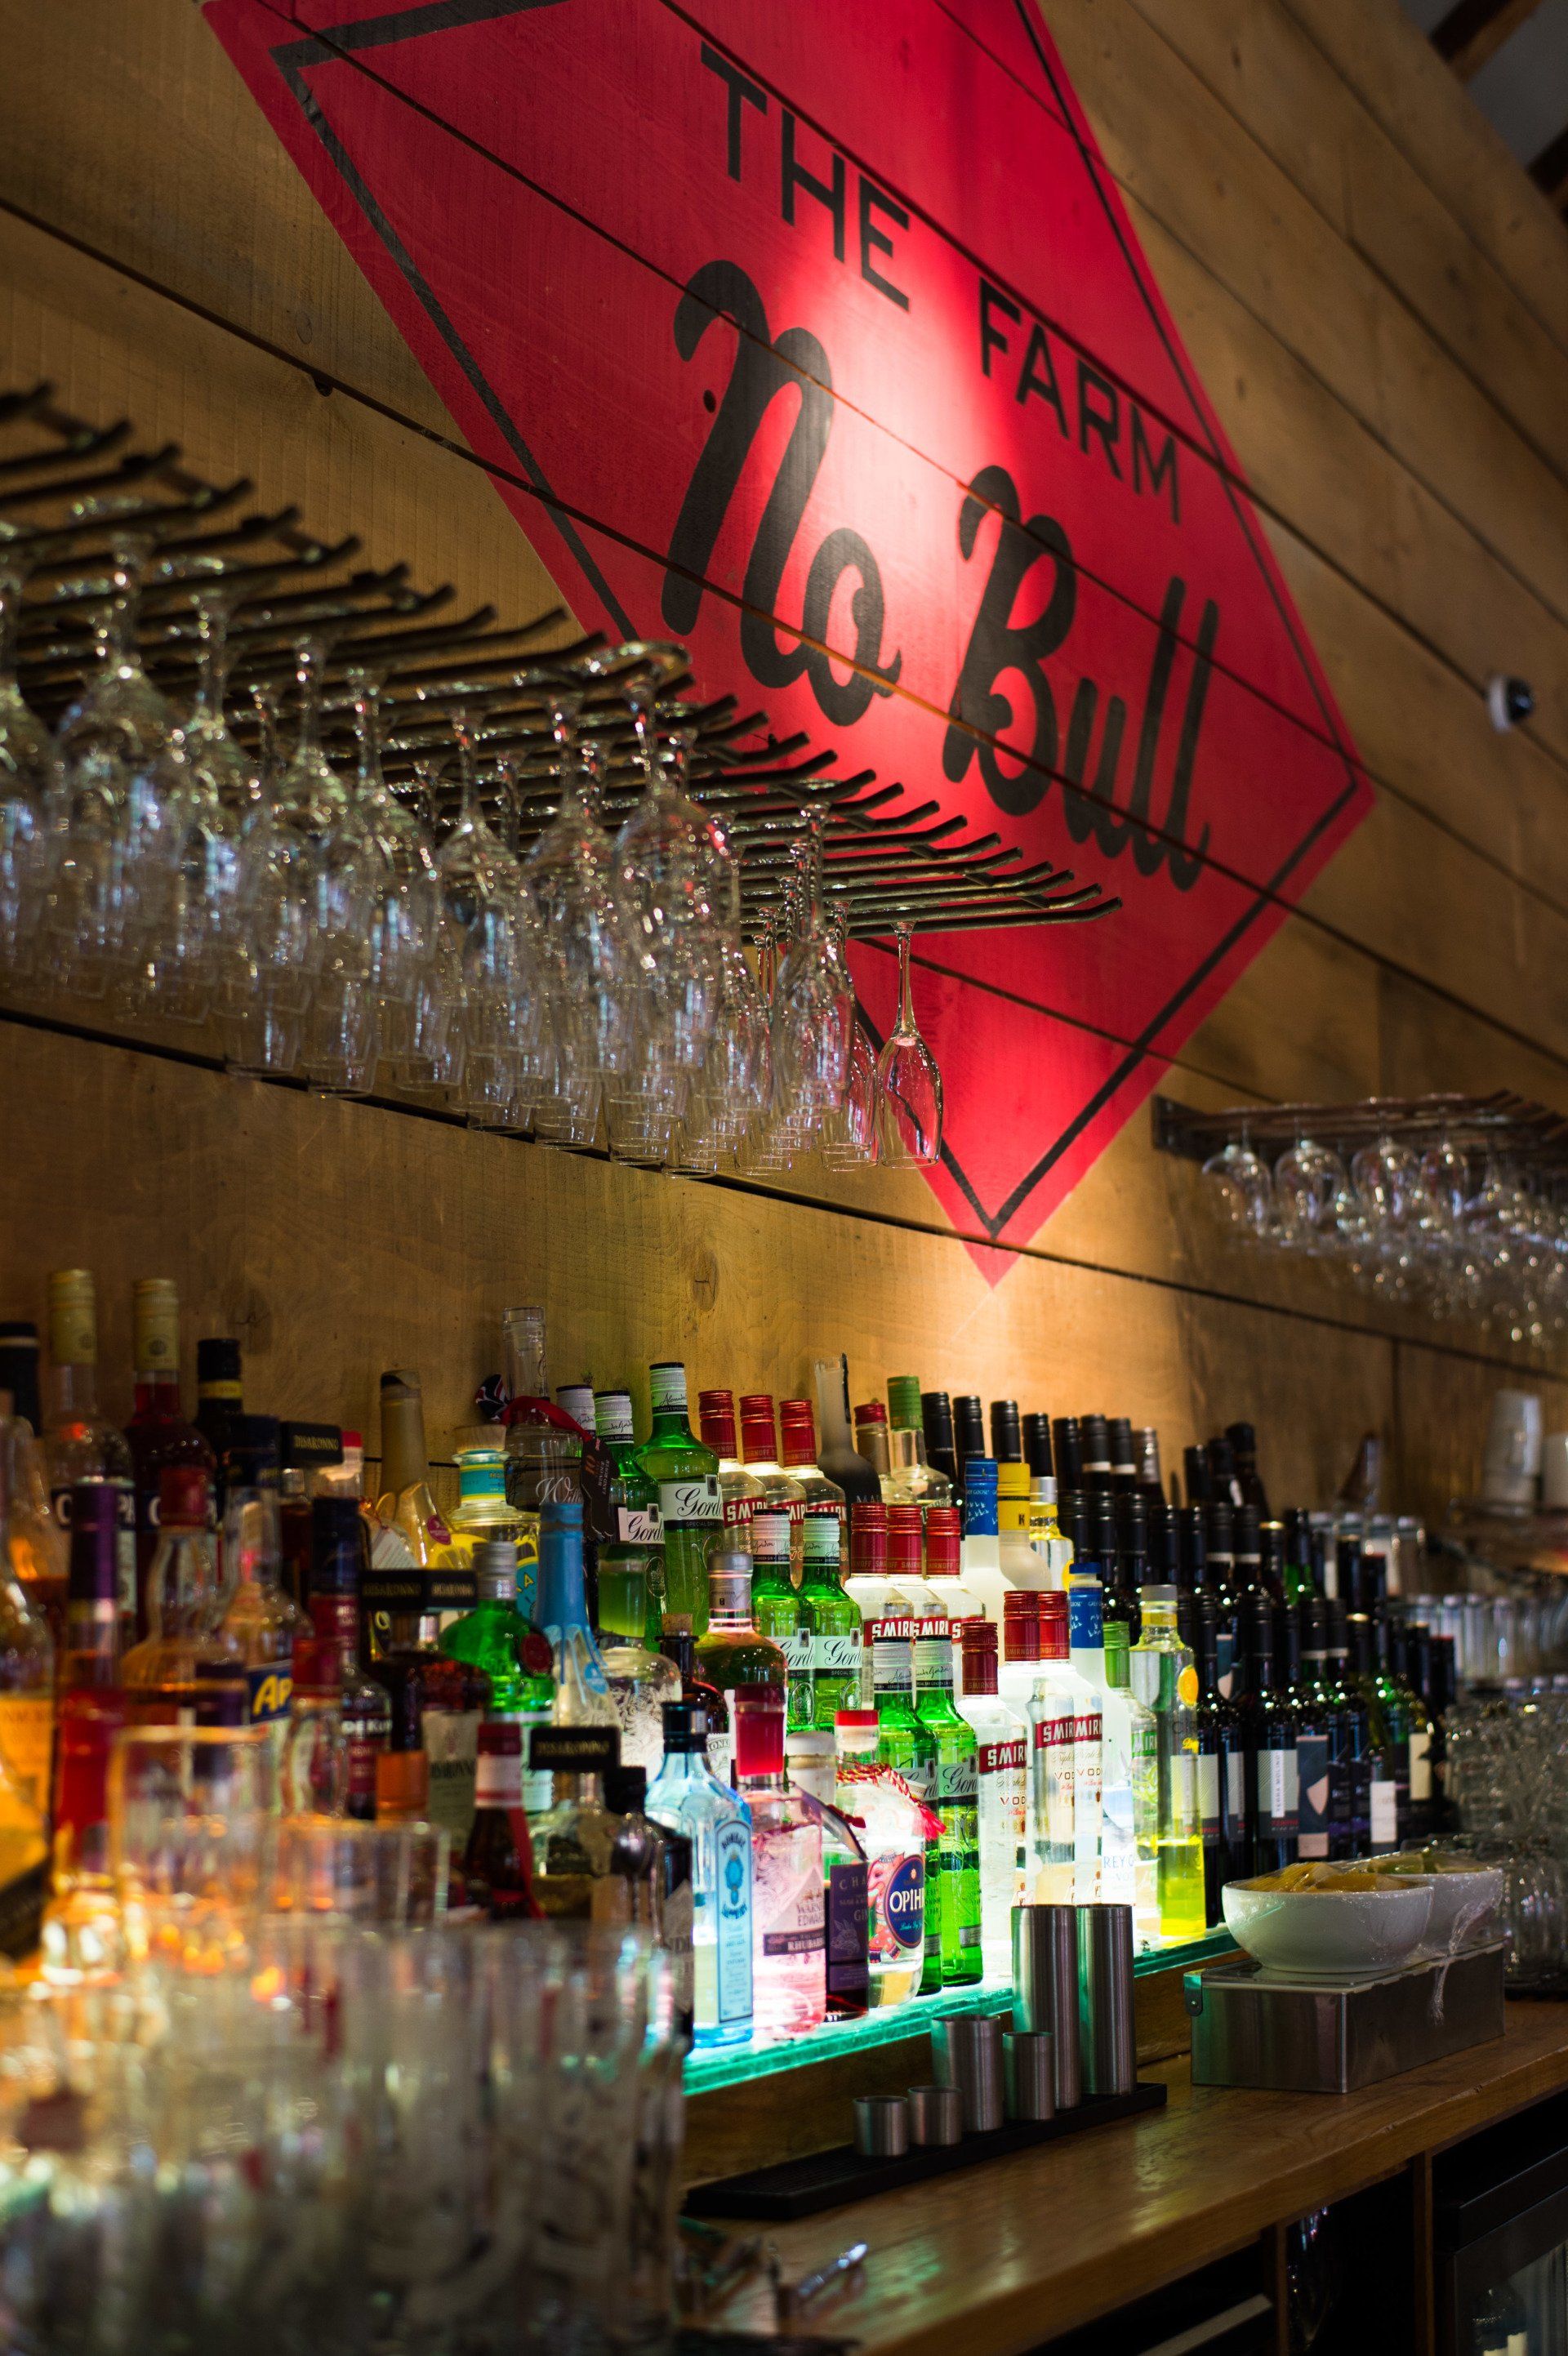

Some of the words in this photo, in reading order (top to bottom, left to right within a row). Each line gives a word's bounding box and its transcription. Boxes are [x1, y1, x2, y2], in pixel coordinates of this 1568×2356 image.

[701, 41, 910, 313] THE
[980, 278, 1180, 526] FARM
[662, 260, 902, 727] No
[942, 465, 1219, 892] Bull
[675, 1487, 722, 1516] Gord
[628, 1514, 664, 1543] Gord
[1075, 1718, 1102, 1738] MIR
